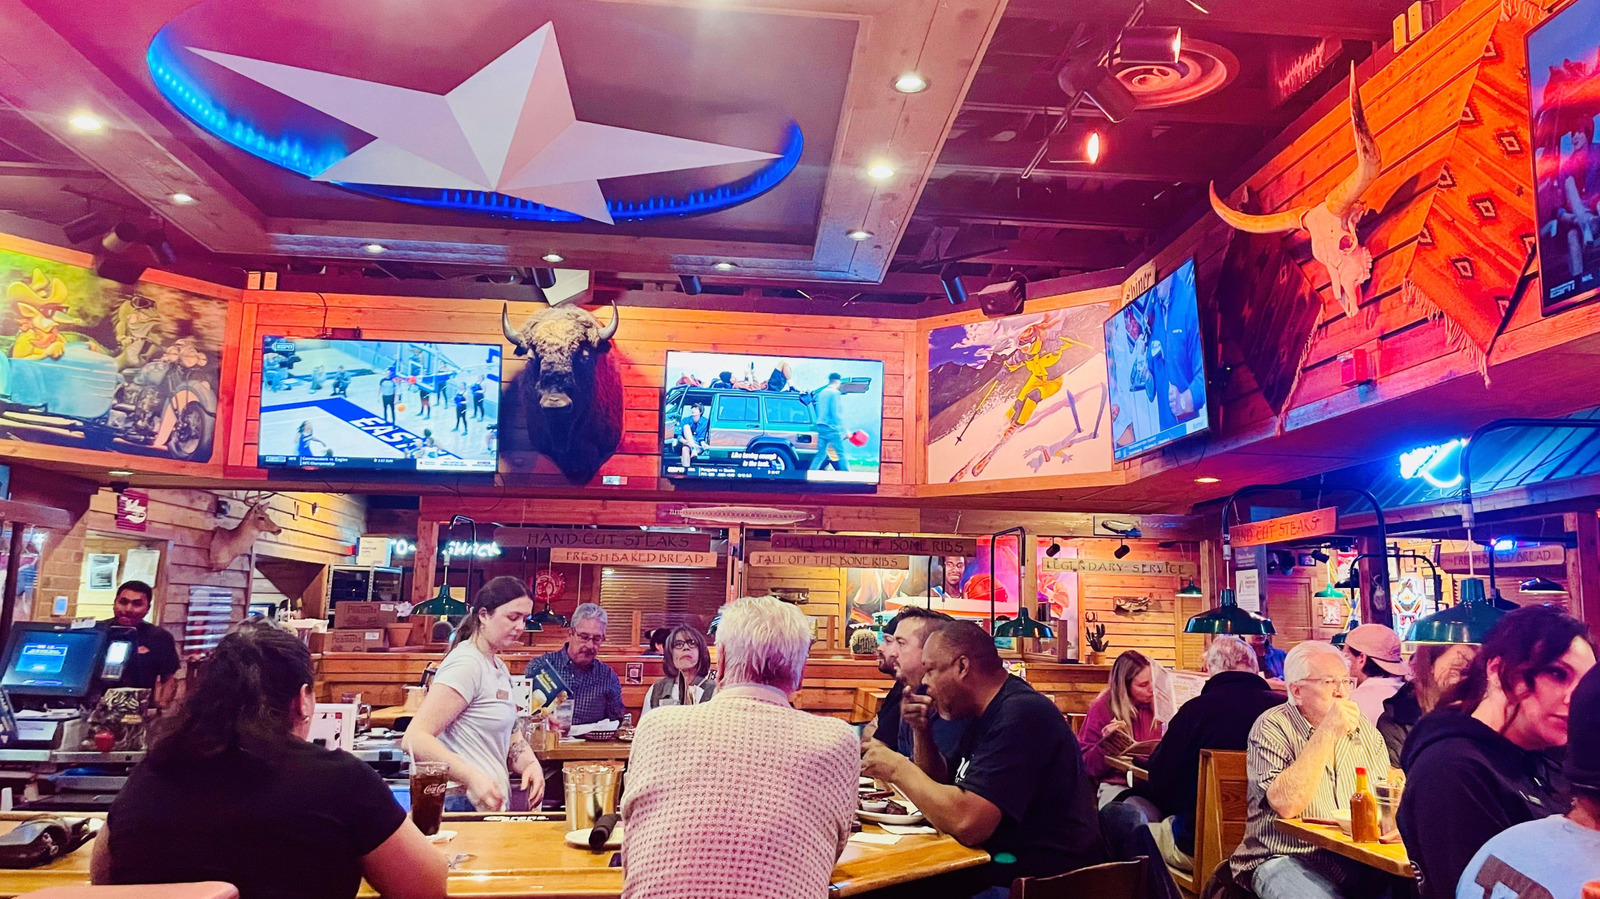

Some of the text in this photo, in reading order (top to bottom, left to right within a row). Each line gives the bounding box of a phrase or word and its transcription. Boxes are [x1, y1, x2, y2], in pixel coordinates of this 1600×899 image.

[1279, 515, 1320, 537] STEAKS
[623, 534, 690, 548] STEAKS
[783, 537, 965, 553] FALL OFF THE BONE RIBS
[566, 550, 704, 565] FRESH BAKED BREAD
[757, 555, 899, 567] FALL OFF THE BONE RIBS
[1517, 549, 1552, 563] BREAD
[1131, 561, 1187, 575] SERVICE
[331, 634, 362, 644] Peanuts
